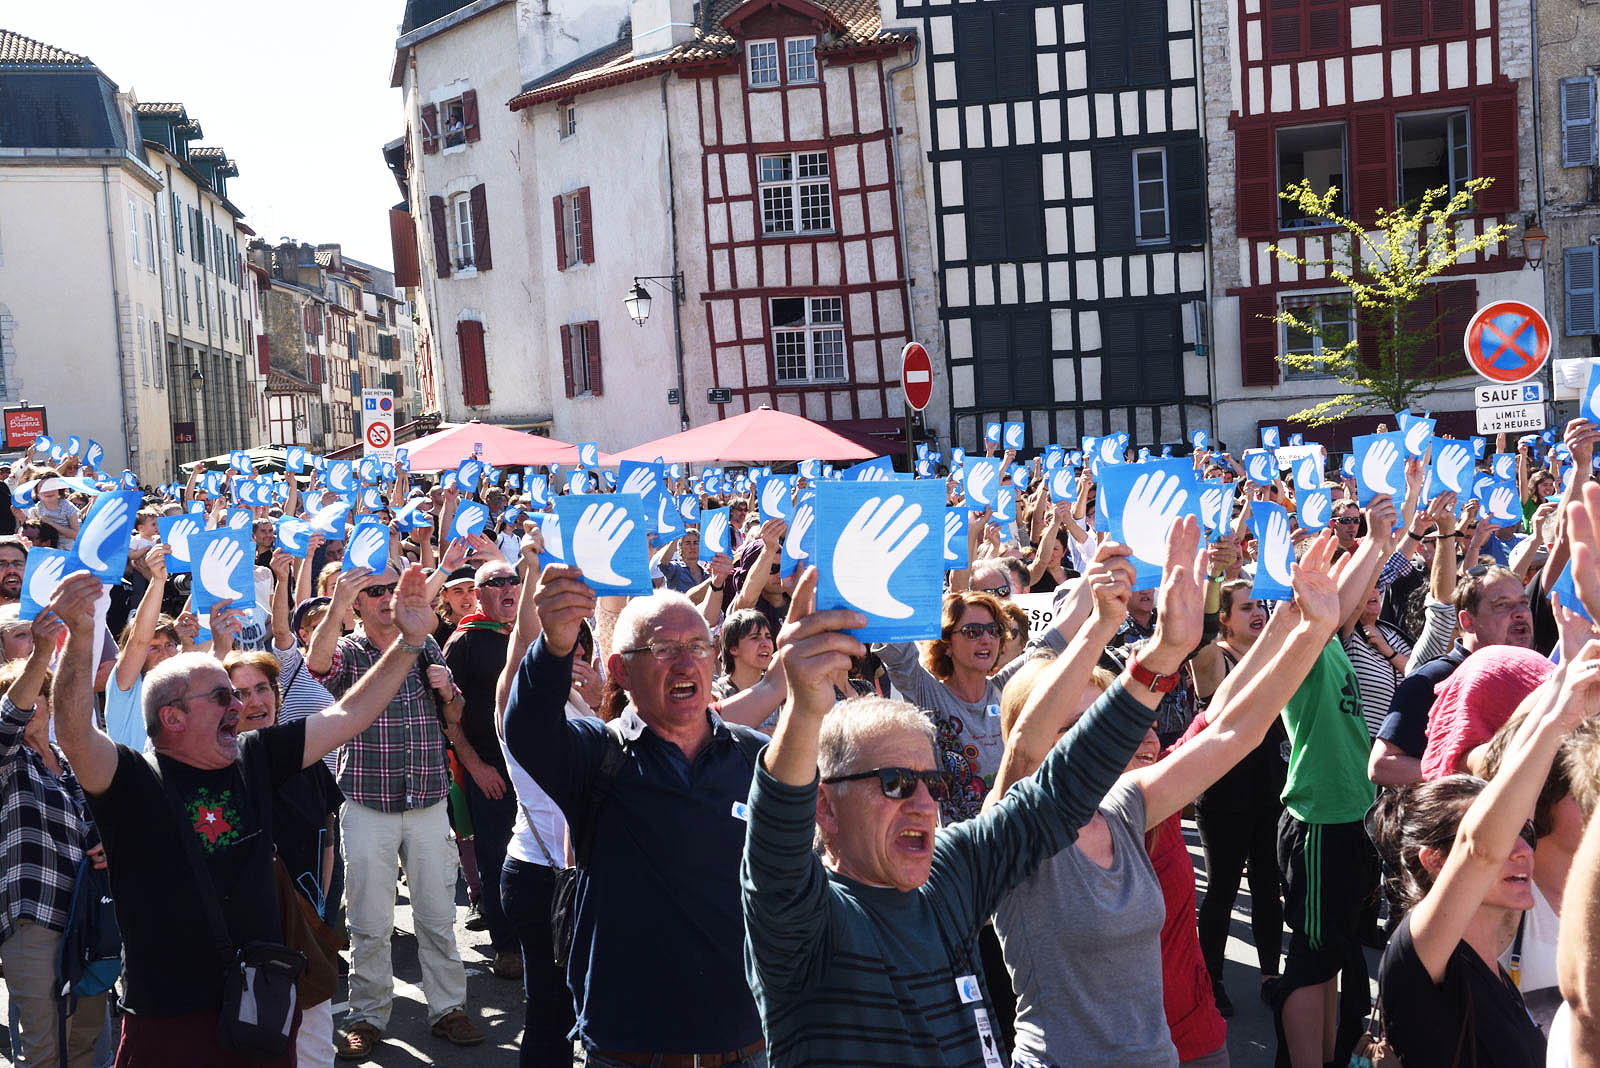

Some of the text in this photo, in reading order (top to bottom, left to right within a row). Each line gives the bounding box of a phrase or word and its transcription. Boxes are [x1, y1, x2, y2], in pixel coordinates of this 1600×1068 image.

[1481, 389, 1518, 402] SAUF
[1495, 409, 1527, 420] LIMITÉ
[1504, 419, 1542, 429] HEURES
